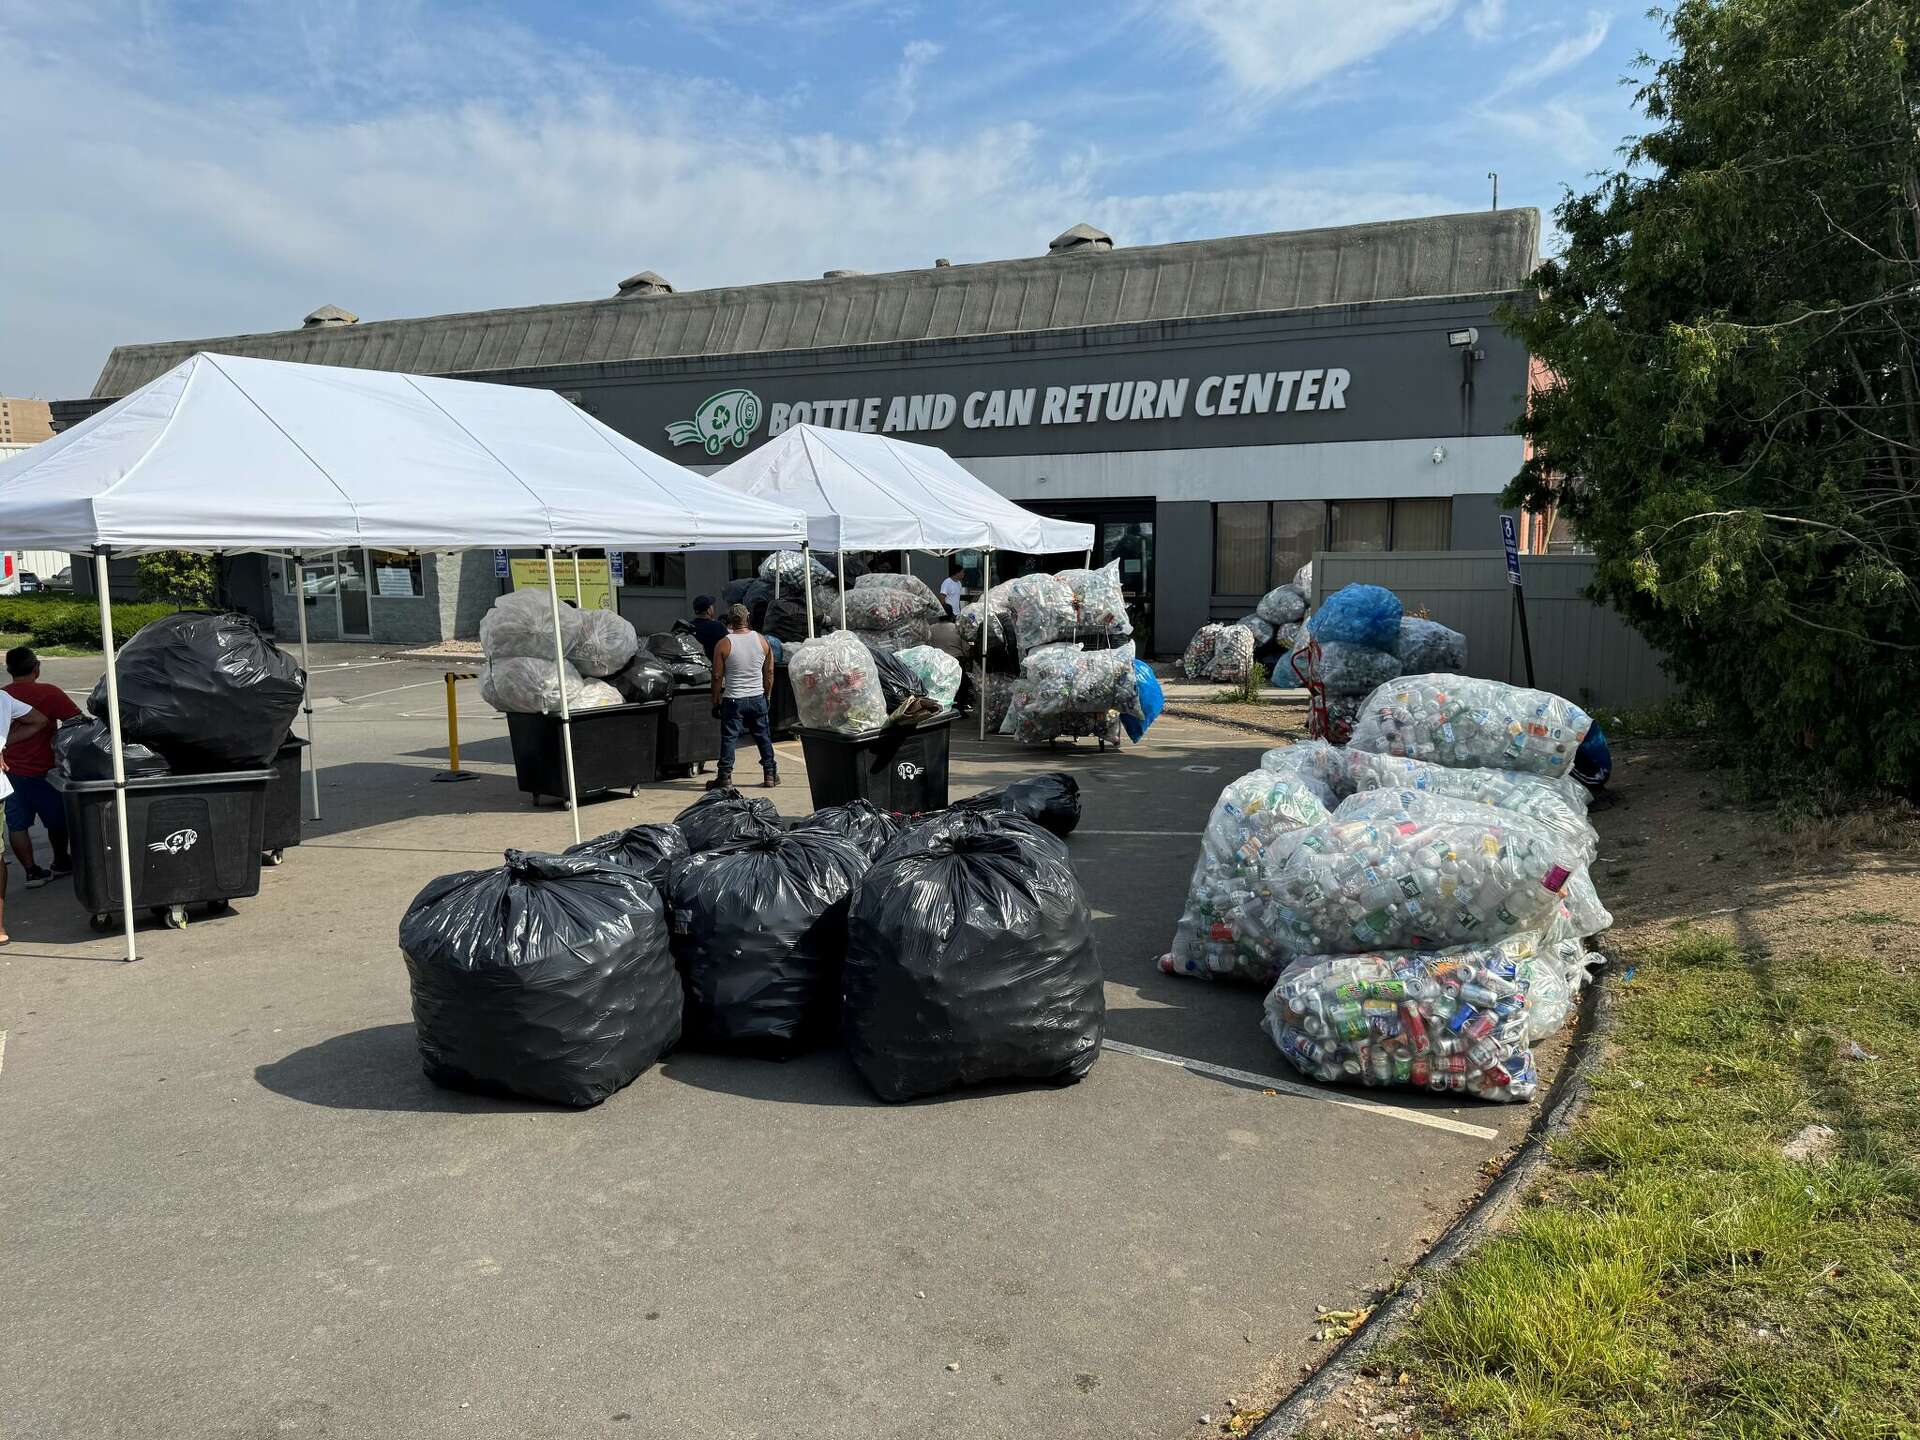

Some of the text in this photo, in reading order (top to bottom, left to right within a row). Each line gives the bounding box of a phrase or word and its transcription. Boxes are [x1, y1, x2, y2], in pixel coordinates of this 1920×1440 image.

[768, 368, 1352, 436] BOTTLE AND CAN RETURN CENTER
